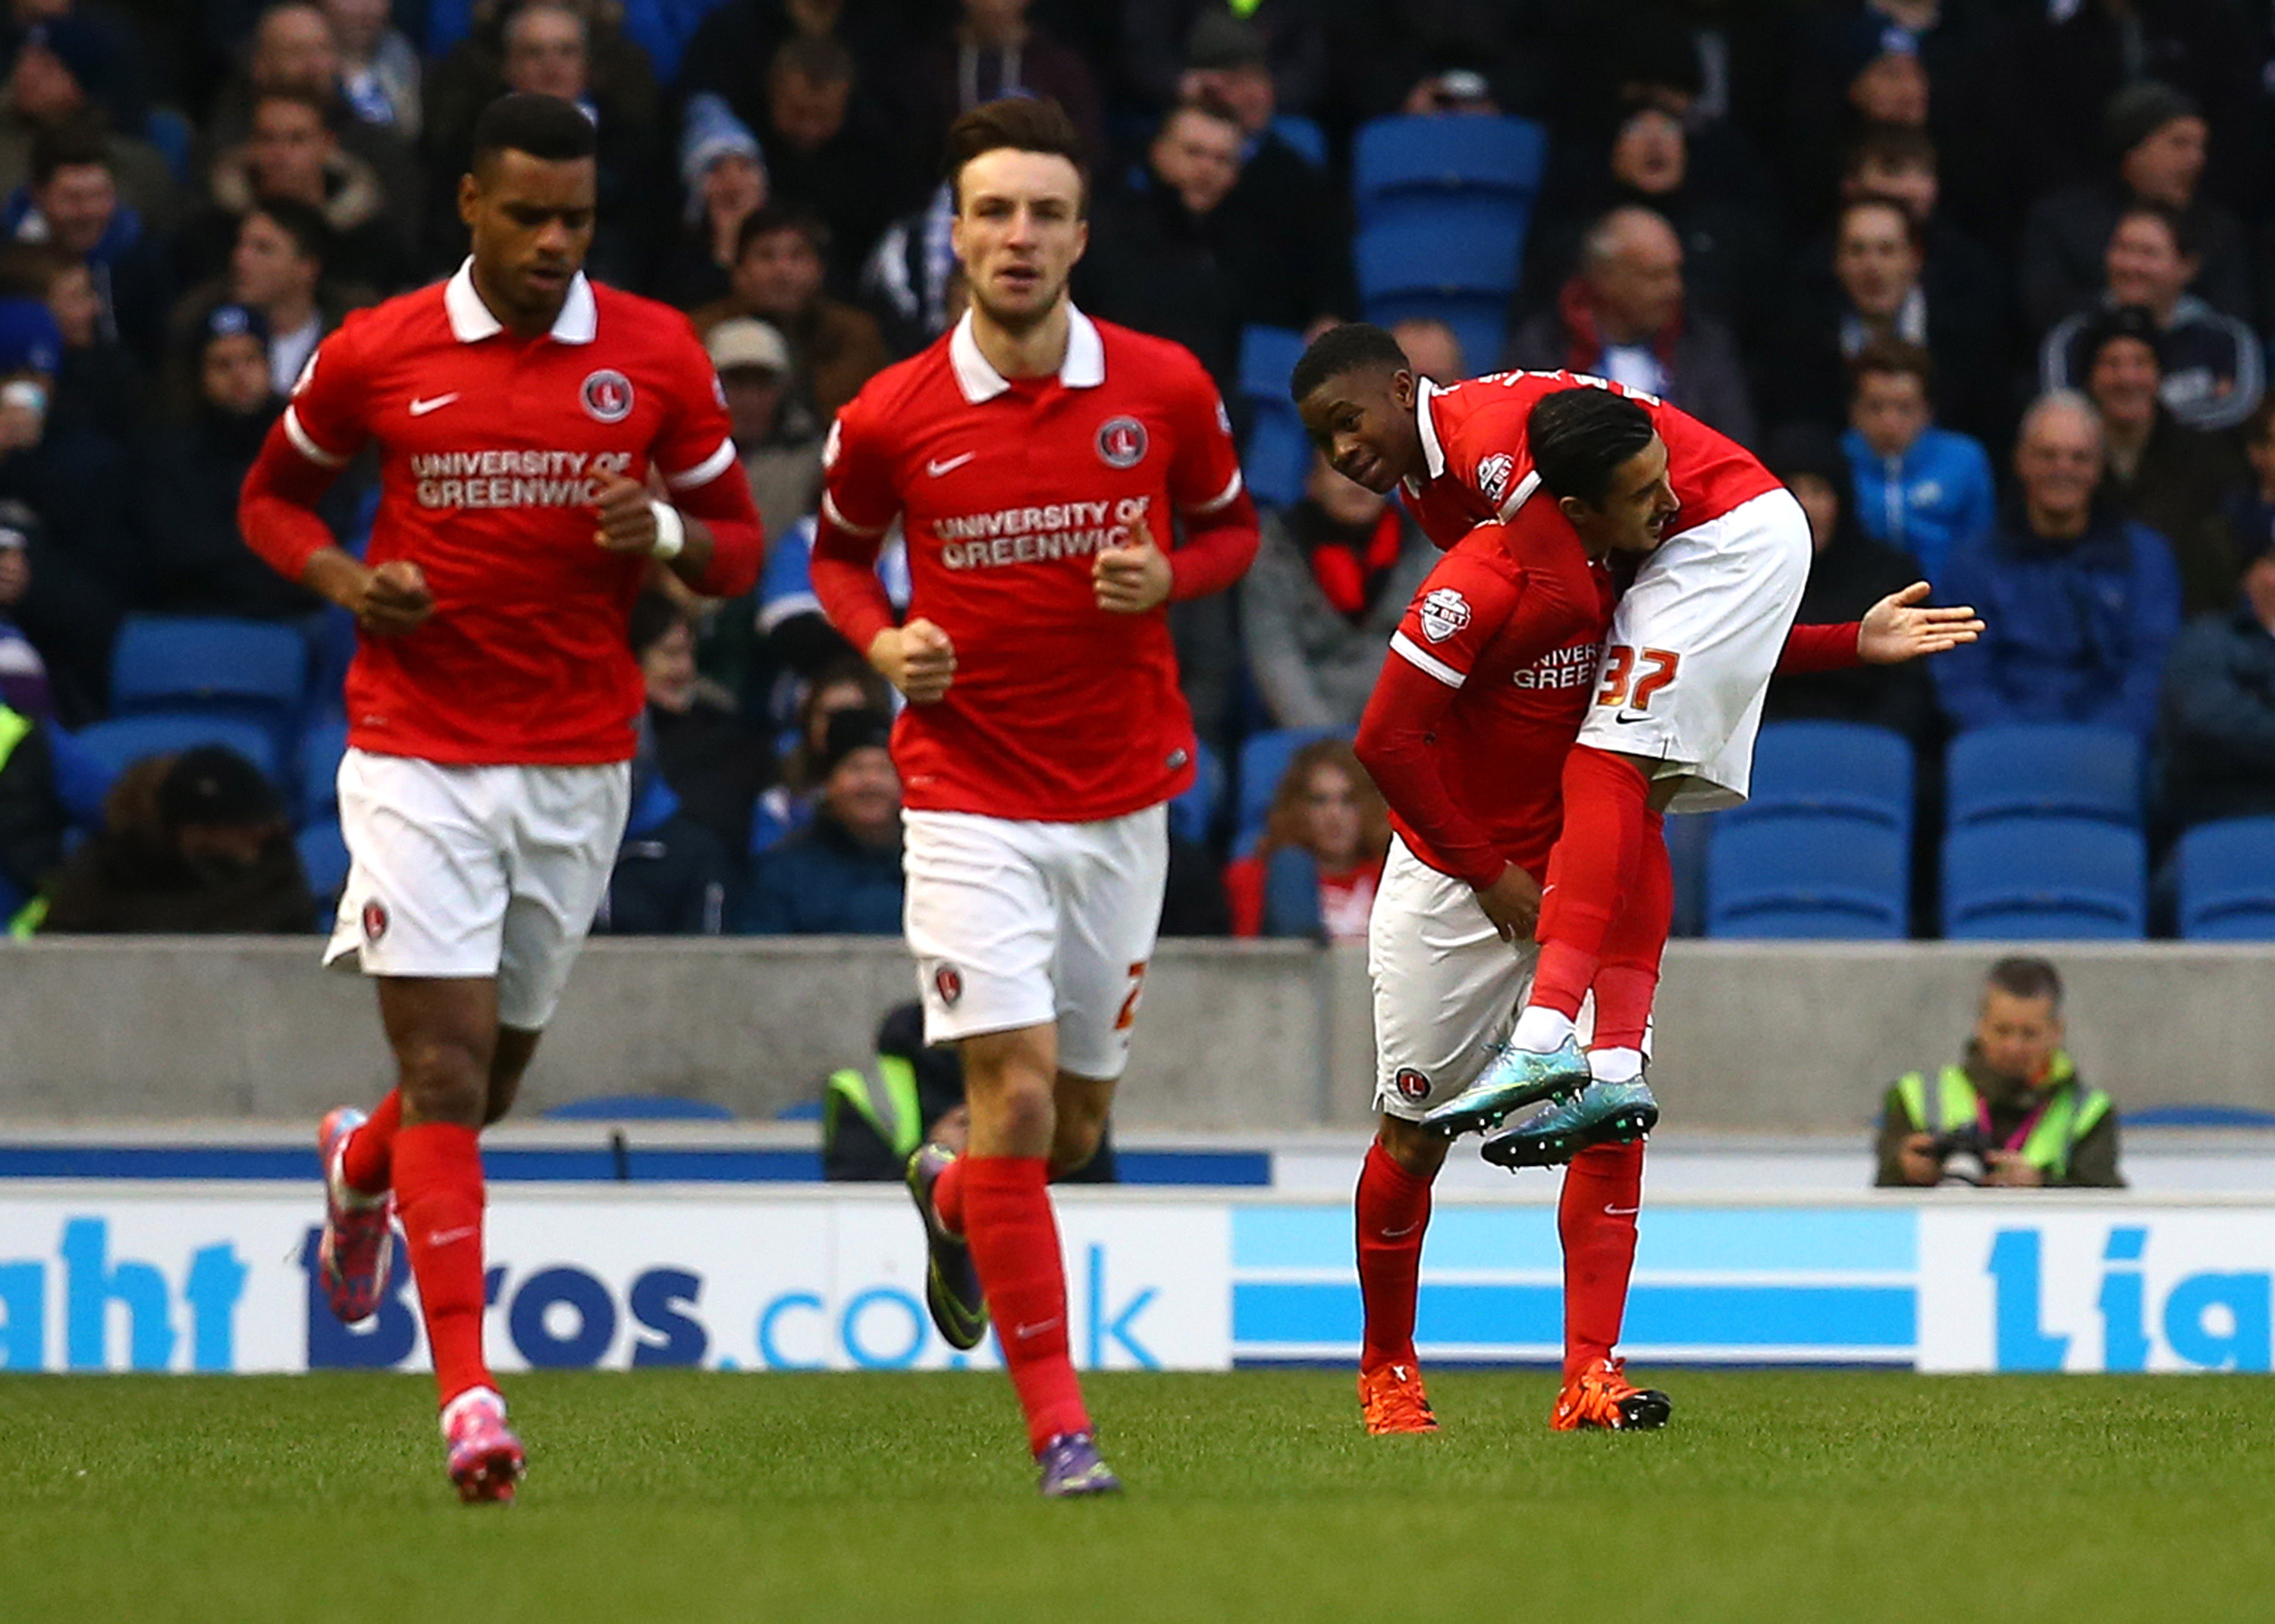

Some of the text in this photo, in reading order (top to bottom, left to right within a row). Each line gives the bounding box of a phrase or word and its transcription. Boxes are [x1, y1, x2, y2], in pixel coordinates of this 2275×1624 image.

[411, 450, 589, 478] UNIVERSITY
[417, 478, 601, 508] GREENWIC
[933, 500, 1109, 540] UNIVERSITY
[941, 525, 1131, 569] GREENWIC
[1596, 645, 1680, 711] 37
